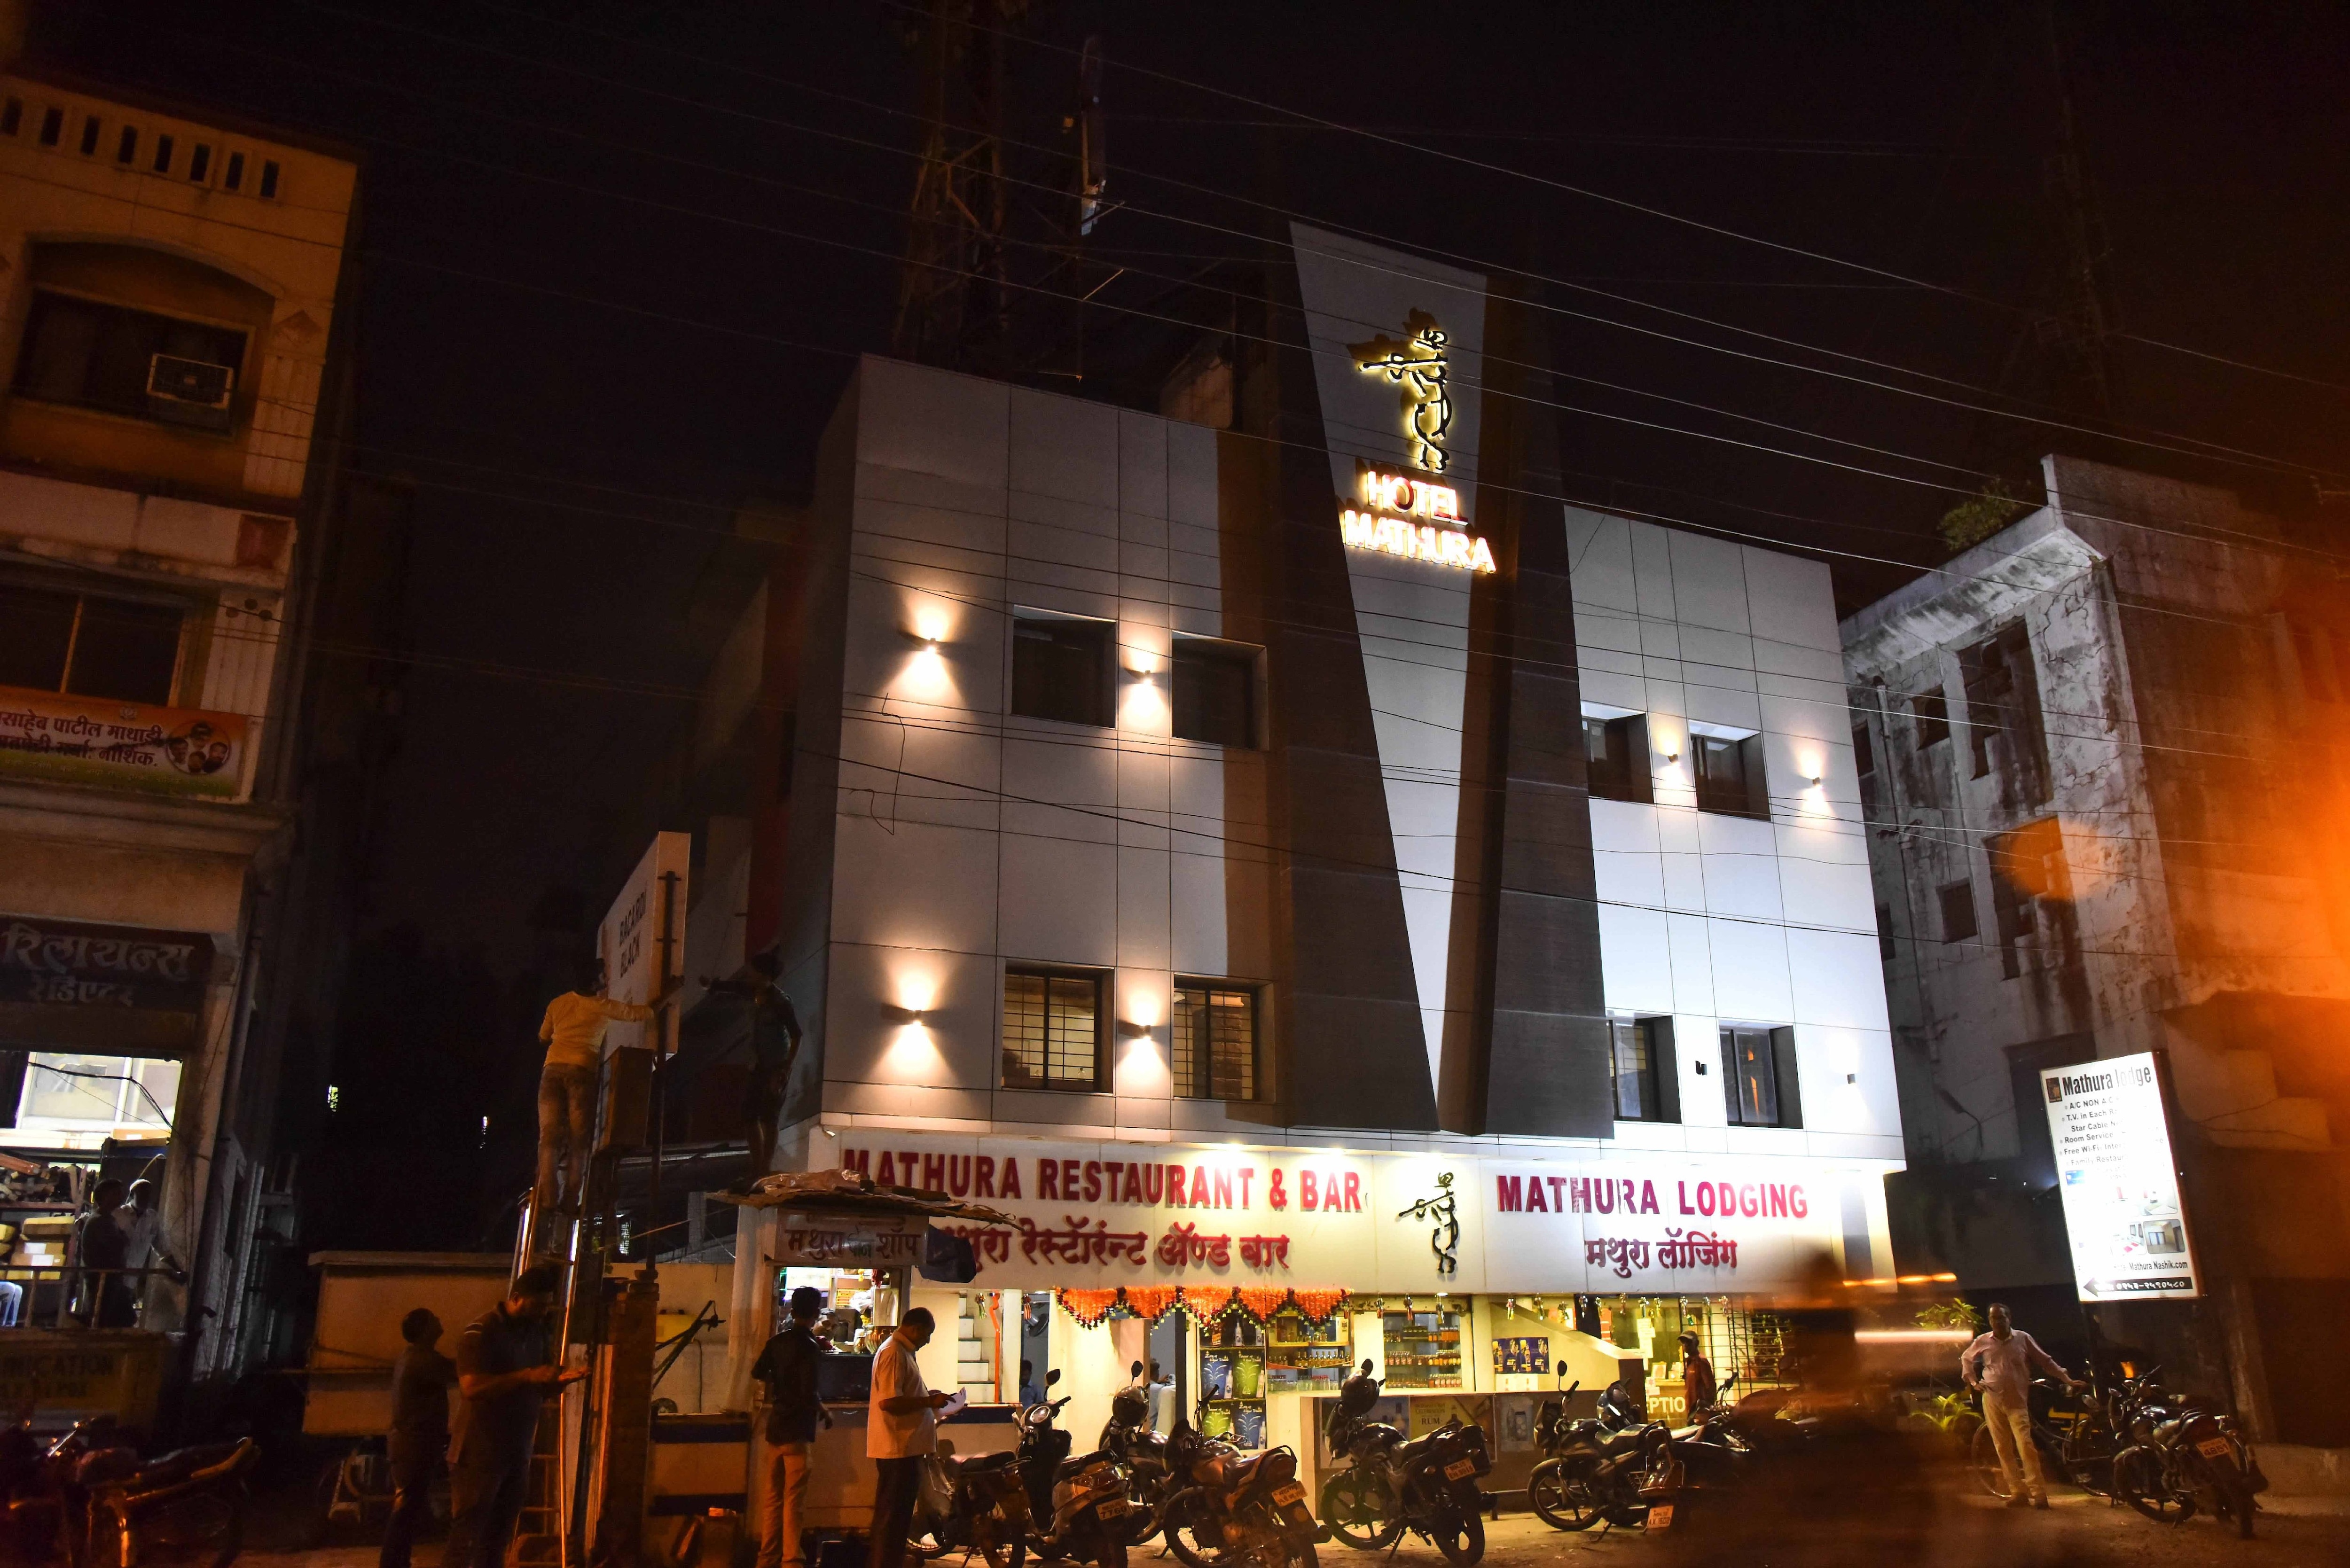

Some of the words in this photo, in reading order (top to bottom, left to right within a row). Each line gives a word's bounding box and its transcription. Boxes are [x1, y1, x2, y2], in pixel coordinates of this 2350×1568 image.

[1367, 471, 1468, 525] HOTEL
[1341, 509, 1496, 574] MATHURA
[0, 709, 49, 731] साहेब
[54, 715, 103, 738] पाटील
[619, 886, 647, 947] BACARDI
[620, 929, 641, 979] BLACK
[2062, 1074, 2113, 1096] Mathura
[2115, 1066, 2152, 1087] lodge
[2083, 1099, 2099, 1108] NON
[2088, 1122, 2108, 1131] Cable
[1038, 1158, 1254, 1209] RESTAURANT
[1269, 1168, 1288, 1211] &
[1300, 1170, 1363, 1213] BAR
[1496, 1175, 1660, 1215] MATHURA
[1678, 1180, 1809, 1218] LODGING
[784, 1229, 845, 1260] मथुरा
[876, 1225, 922, 1259] शॉप
[1239, 1234, 1290, 1269] बार
[1585, 1236, 1650, 1278] मथुरा
[1656, 1227, 1738, 1270] लॉजिंग
[2153, 1260, 2187, 1270] Nashik.com
